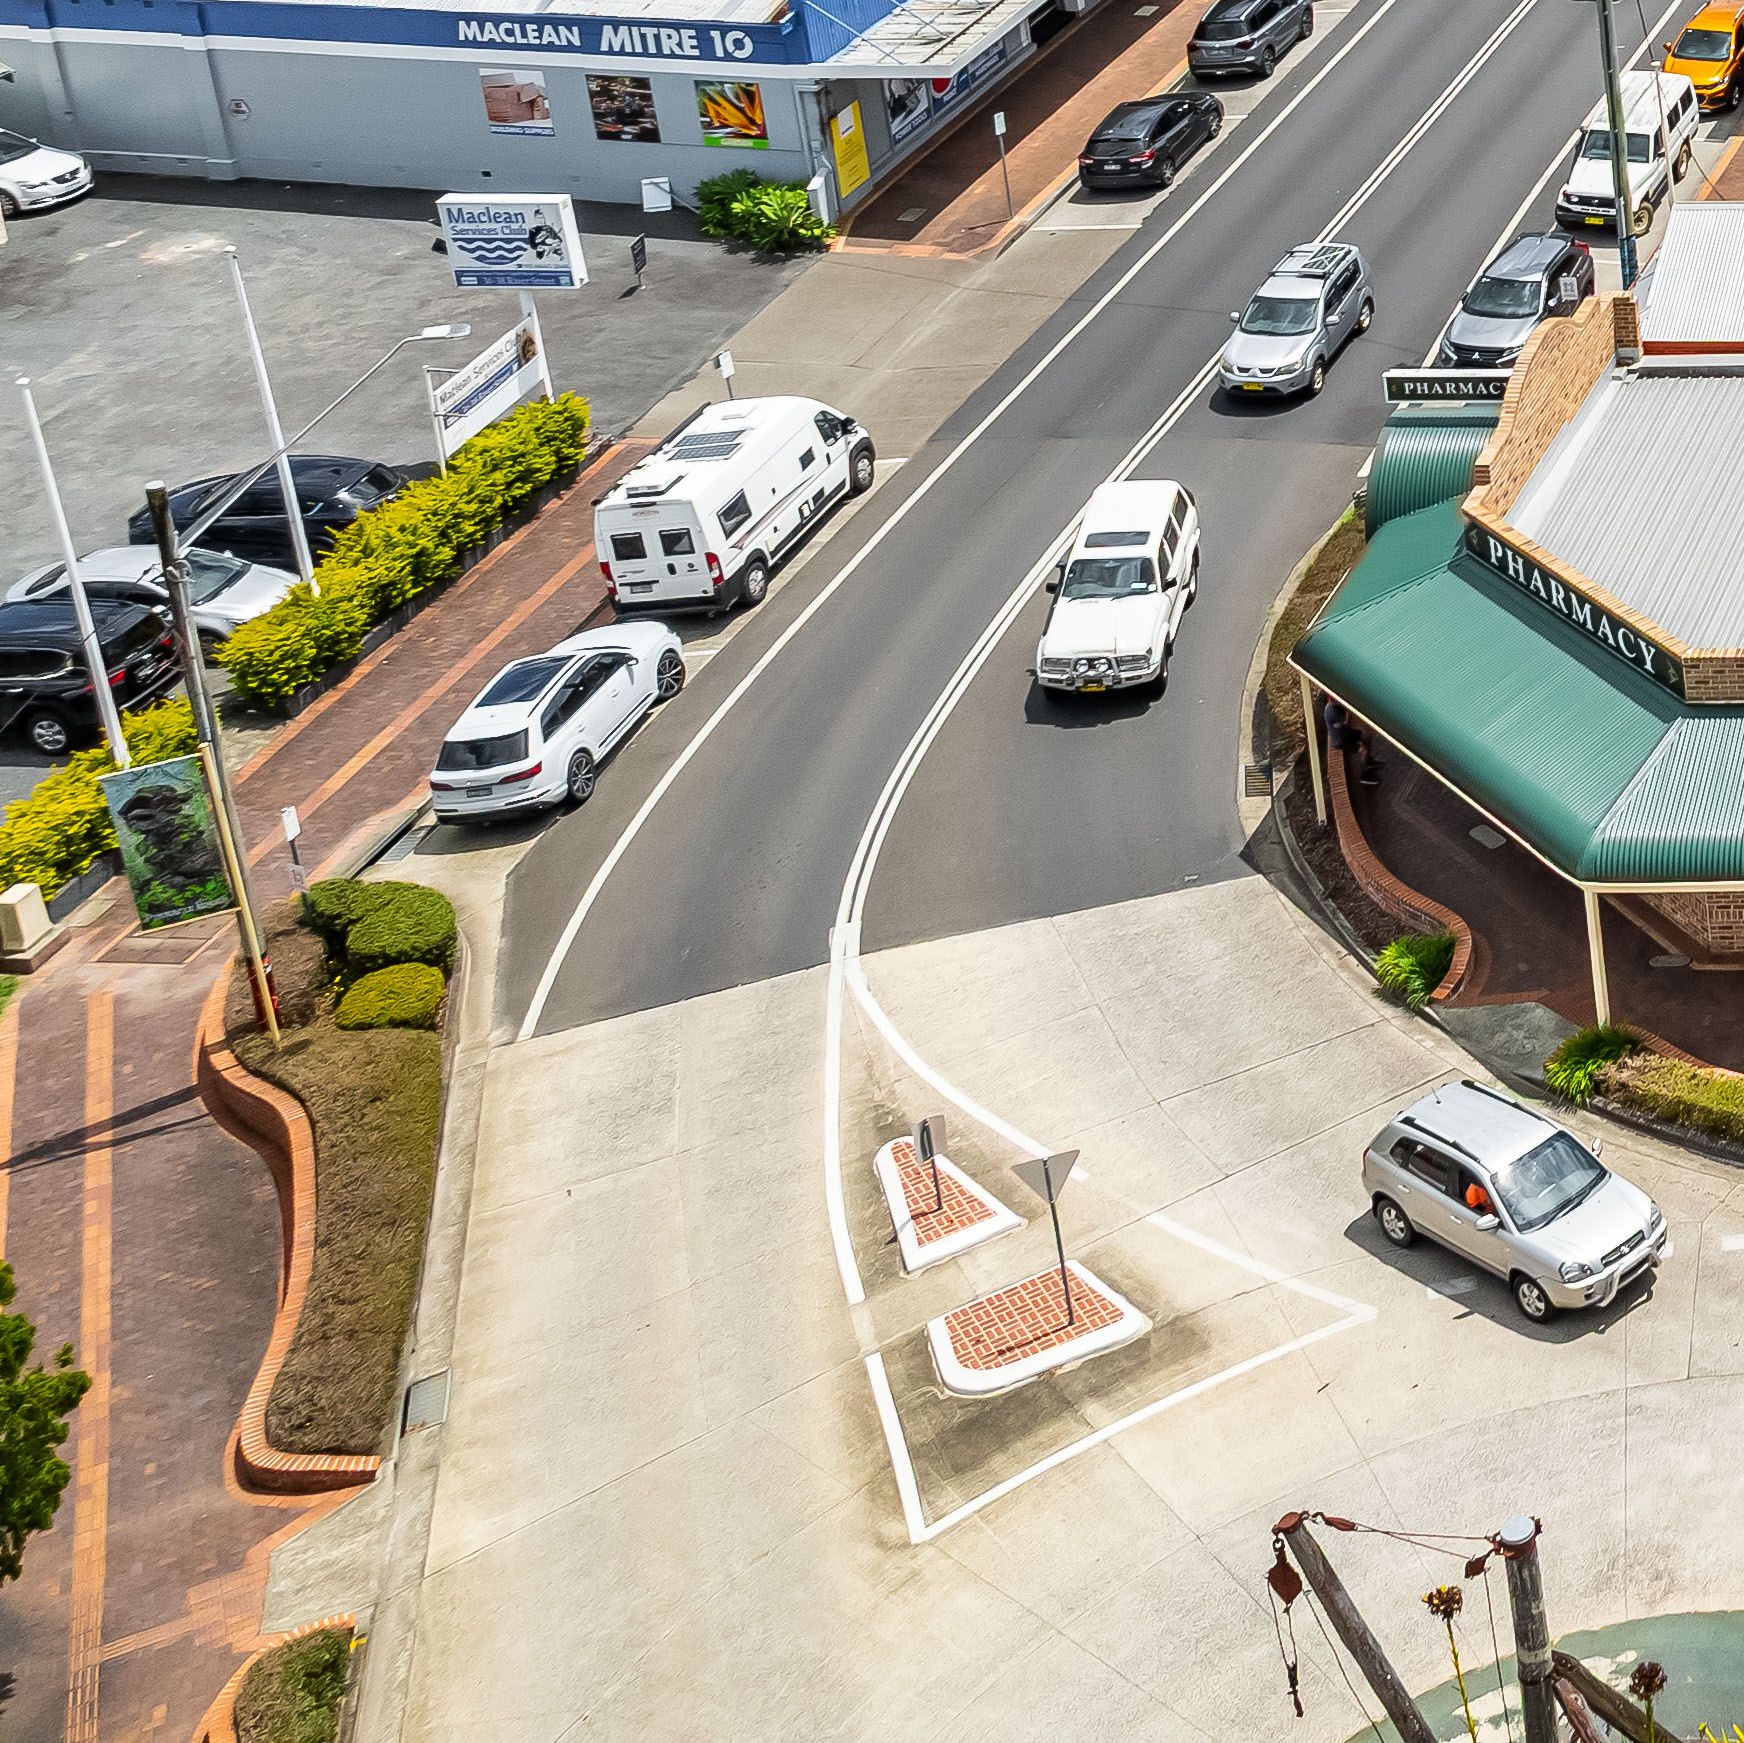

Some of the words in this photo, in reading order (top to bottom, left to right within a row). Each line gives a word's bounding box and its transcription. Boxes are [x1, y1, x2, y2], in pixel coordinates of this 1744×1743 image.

[458, 20, 581, 46] MACLEAN
[600, 25, 700, 56] MITRE
[710, 30, 754, 59] 10
[446, 207, 526, 224] Maclean
[452, 225, 499, 236] Services
[501, 225, 528, 236] Club
[1486, 535, 1656, 674] PHARMACY
